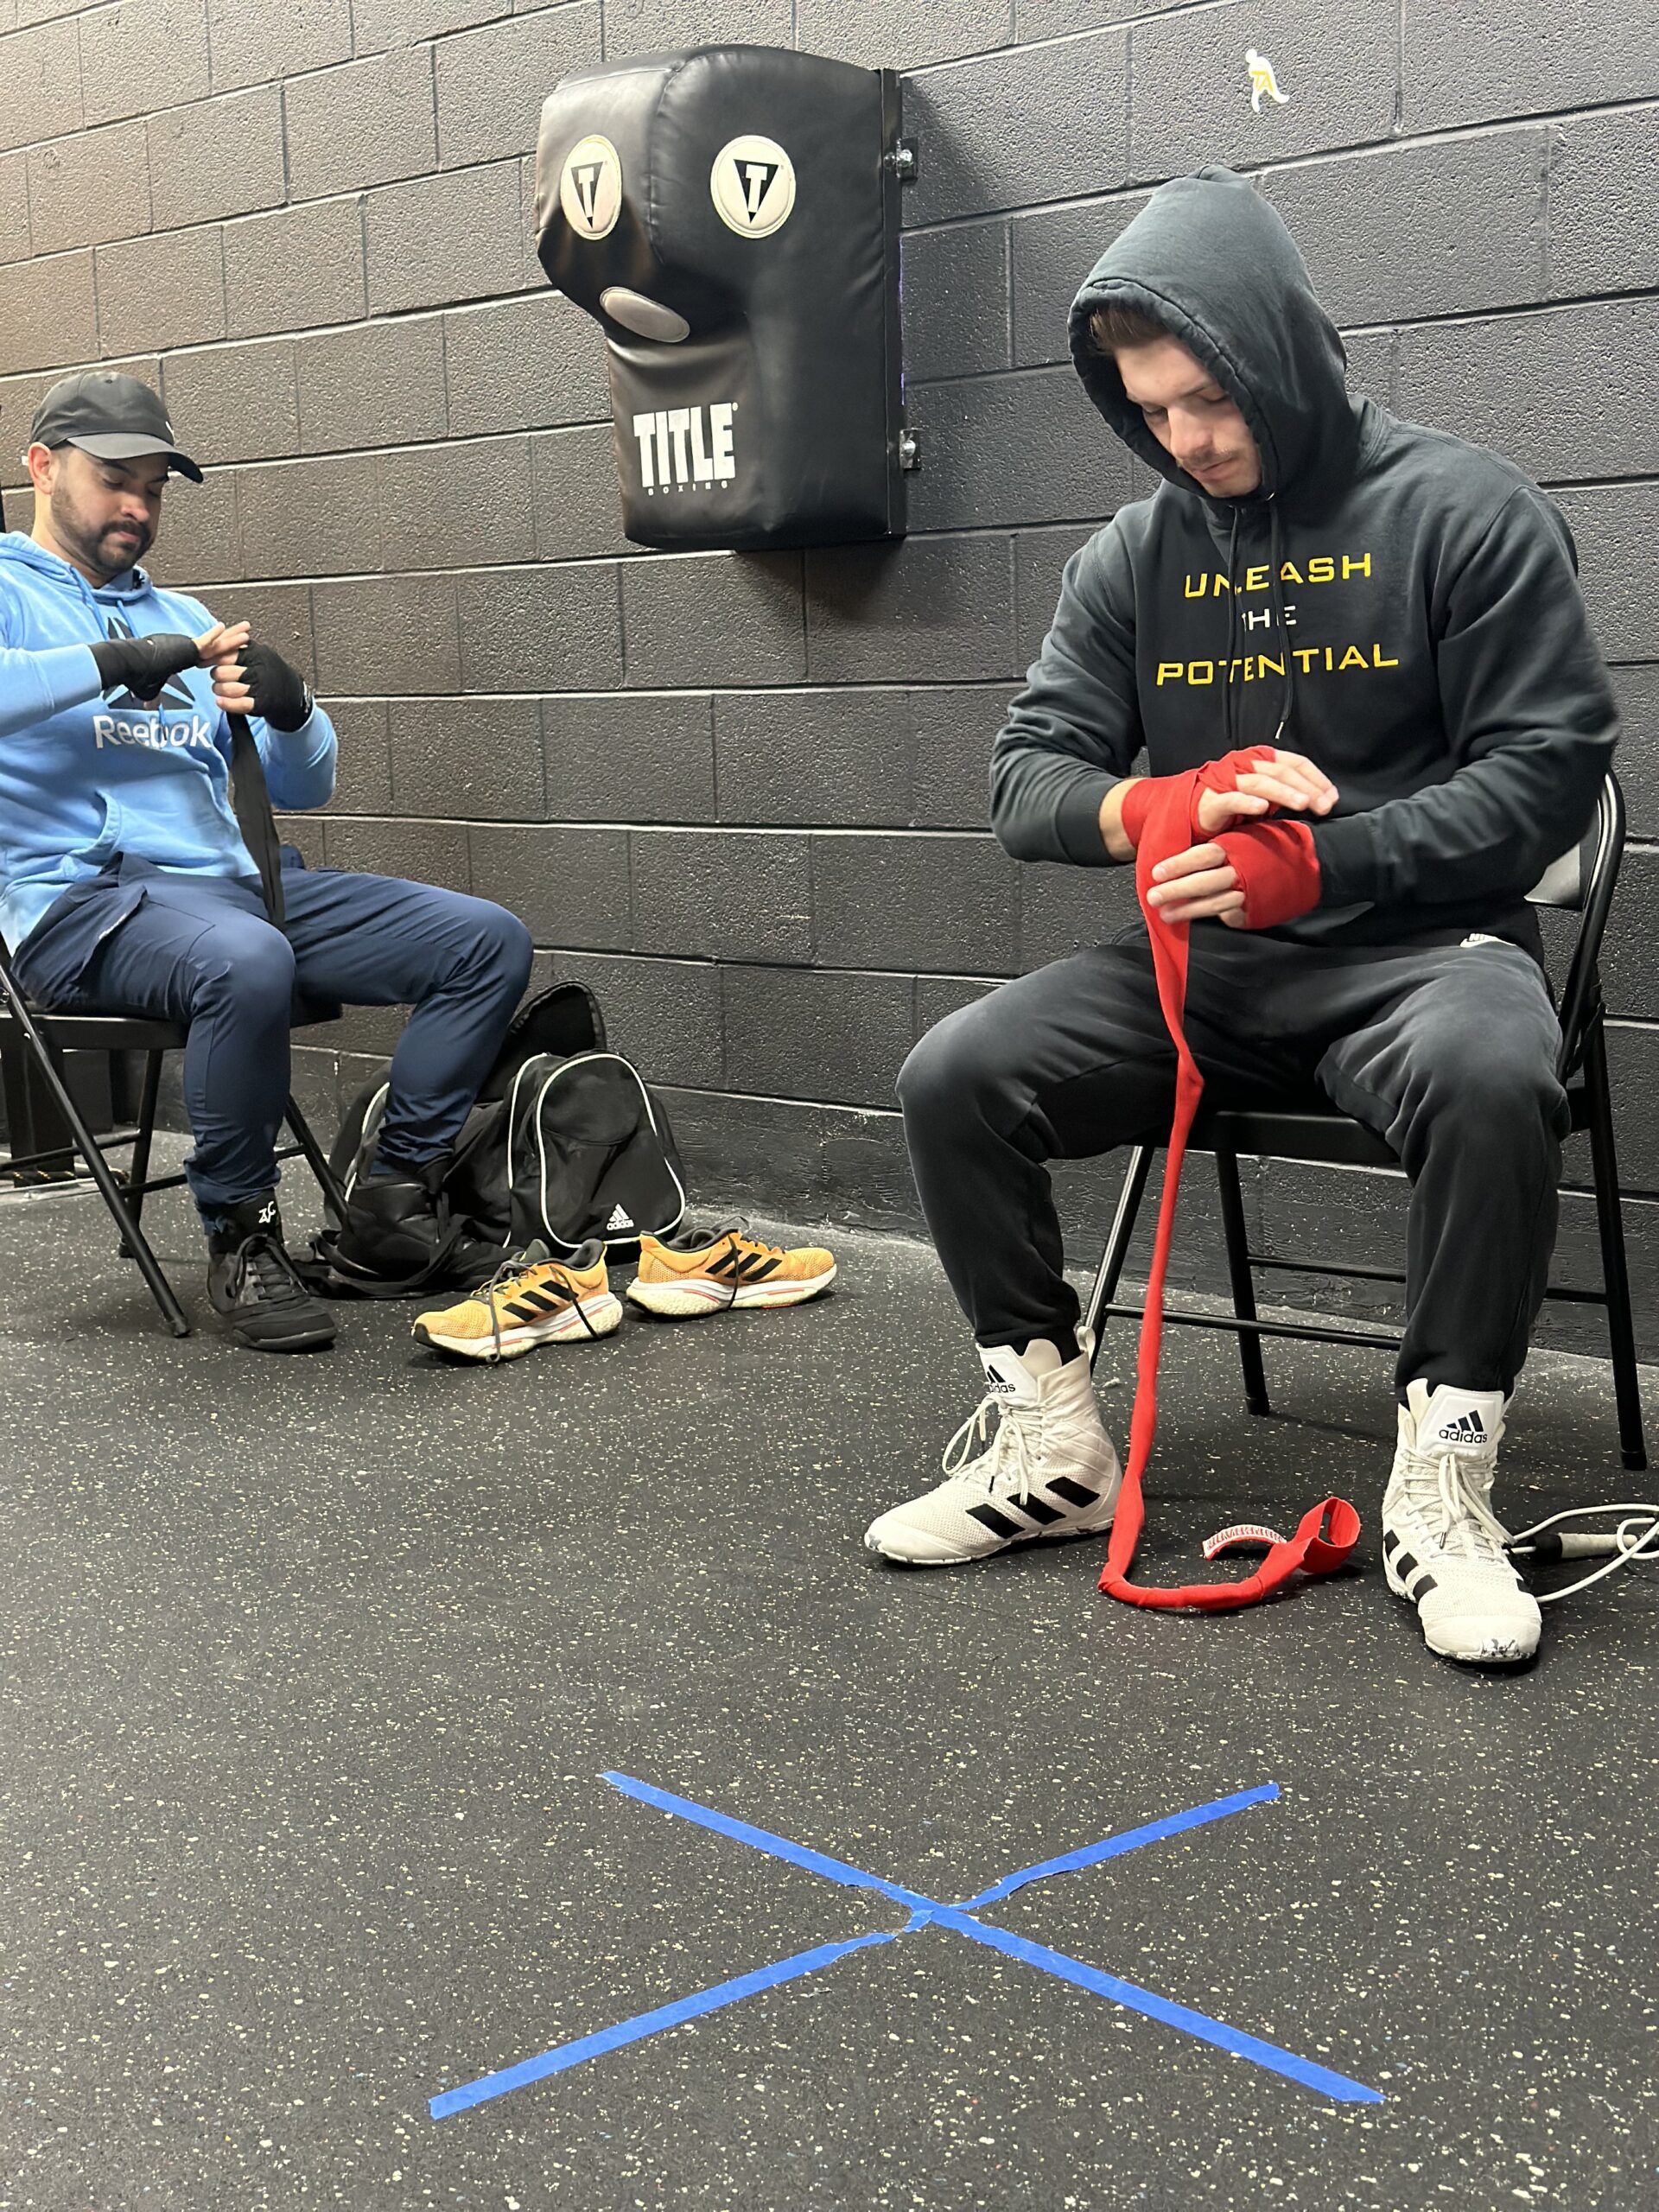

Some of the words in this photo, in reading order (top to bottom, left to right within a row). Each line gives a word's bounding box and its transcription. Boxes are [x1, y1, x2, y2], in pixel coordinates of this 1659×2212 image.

[633, 403, 735, 487] TITLE
[1156, 644, 1399, 685] POTENTIAL
[92, 715, 212, 749] Reebok
[1439, 1429, 1488, 1444] adidas
